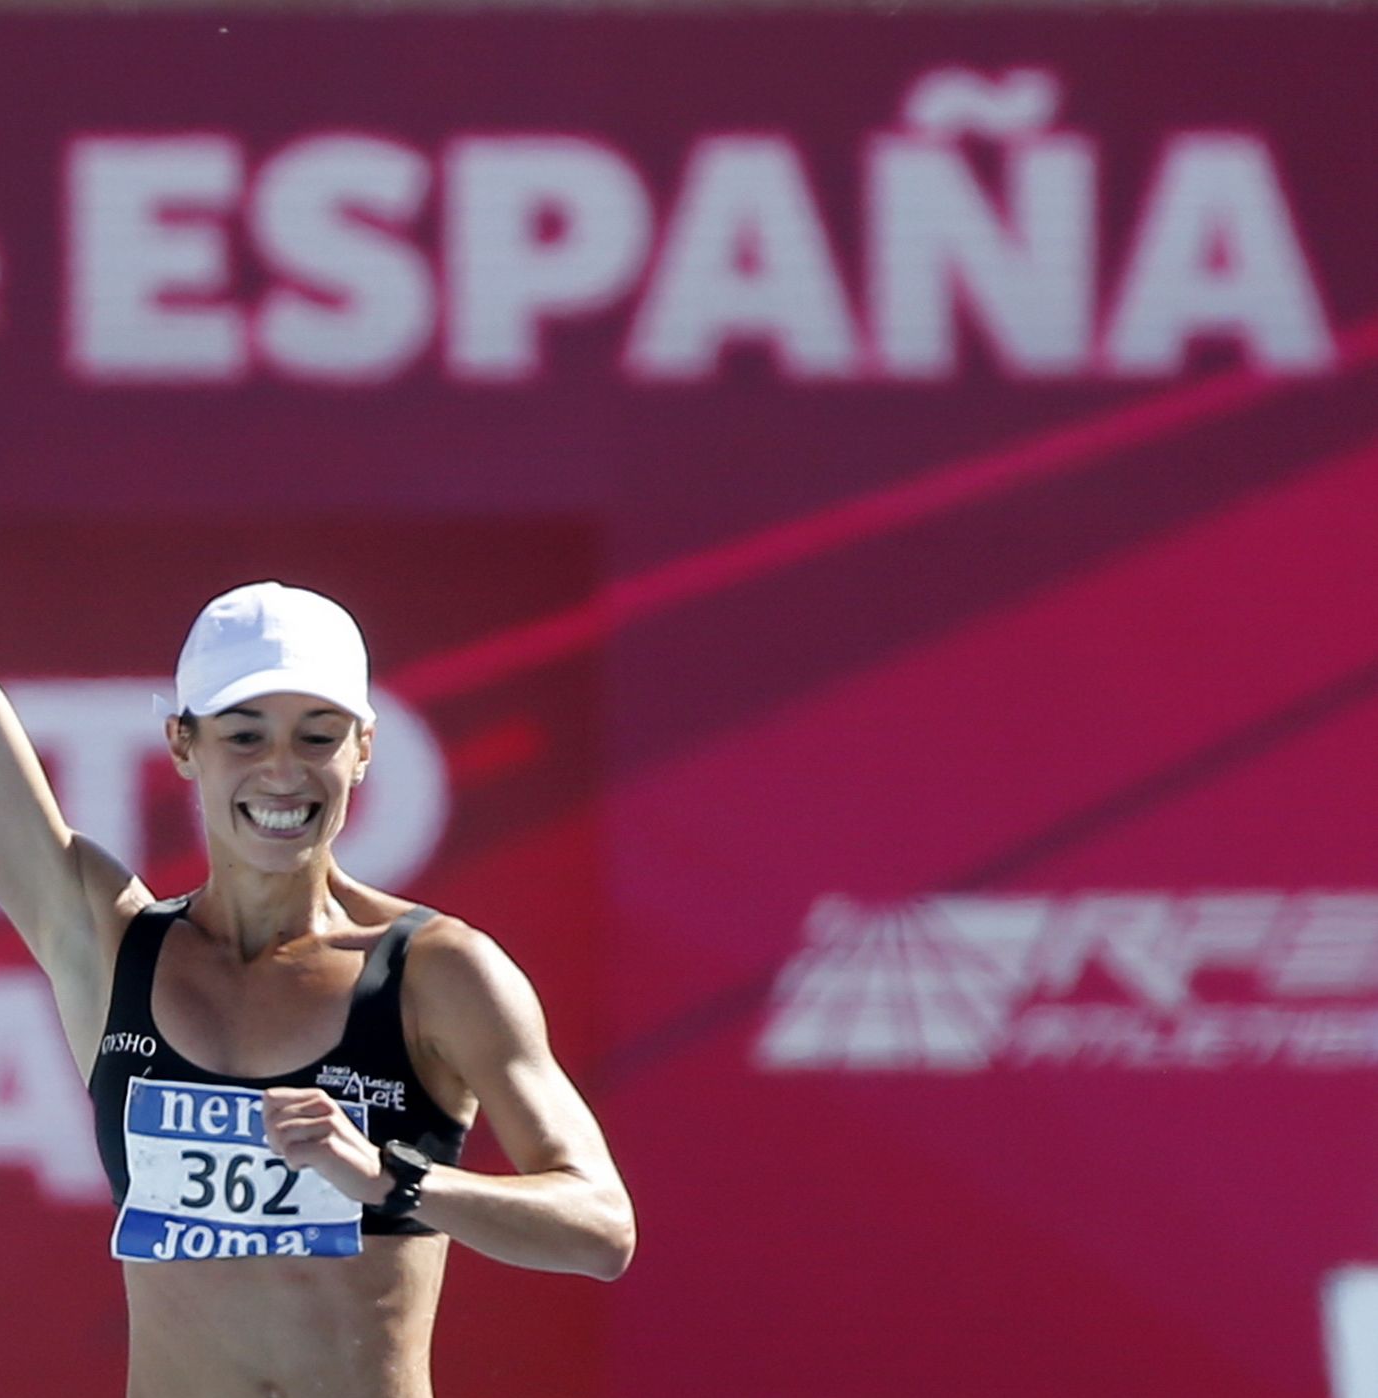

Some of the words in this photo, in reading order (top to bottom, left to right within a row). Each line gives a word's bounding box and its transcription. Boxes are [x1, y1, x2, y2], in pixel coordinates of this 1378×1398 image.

[67, 70, 1335, 380] ESPAÑA
[1043, 890, 1378, 1005] RFE
[159, 1089, 271, 1144] ner
[179, 1150, 300, 1216] 362
